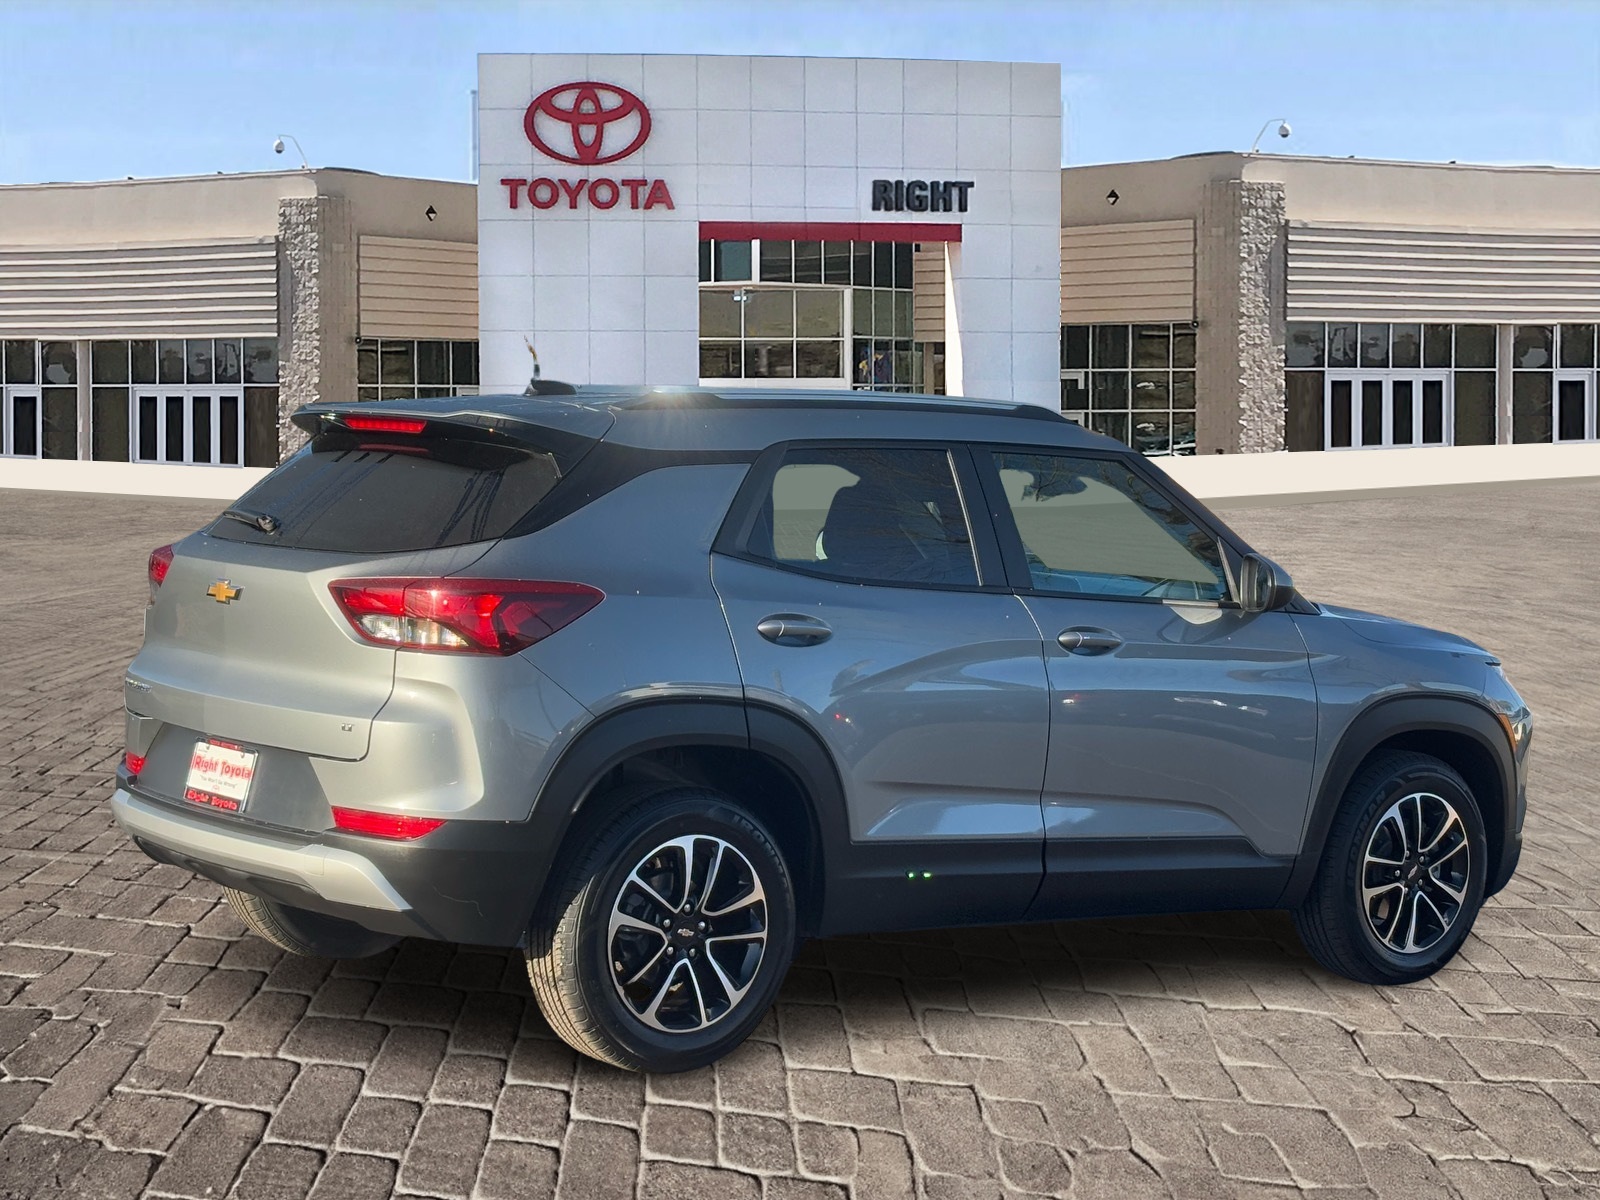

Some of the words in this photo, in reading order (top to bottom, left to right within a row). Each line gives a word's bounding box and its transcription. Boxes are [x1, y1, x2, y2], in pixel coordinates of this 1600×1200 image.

[500, 178, 675, 210] TOYOTA
[871, 179, 975, 213] RIGHT
[193, 755, 218, 773] Right
[221, 760, 252, 779] Toyota
